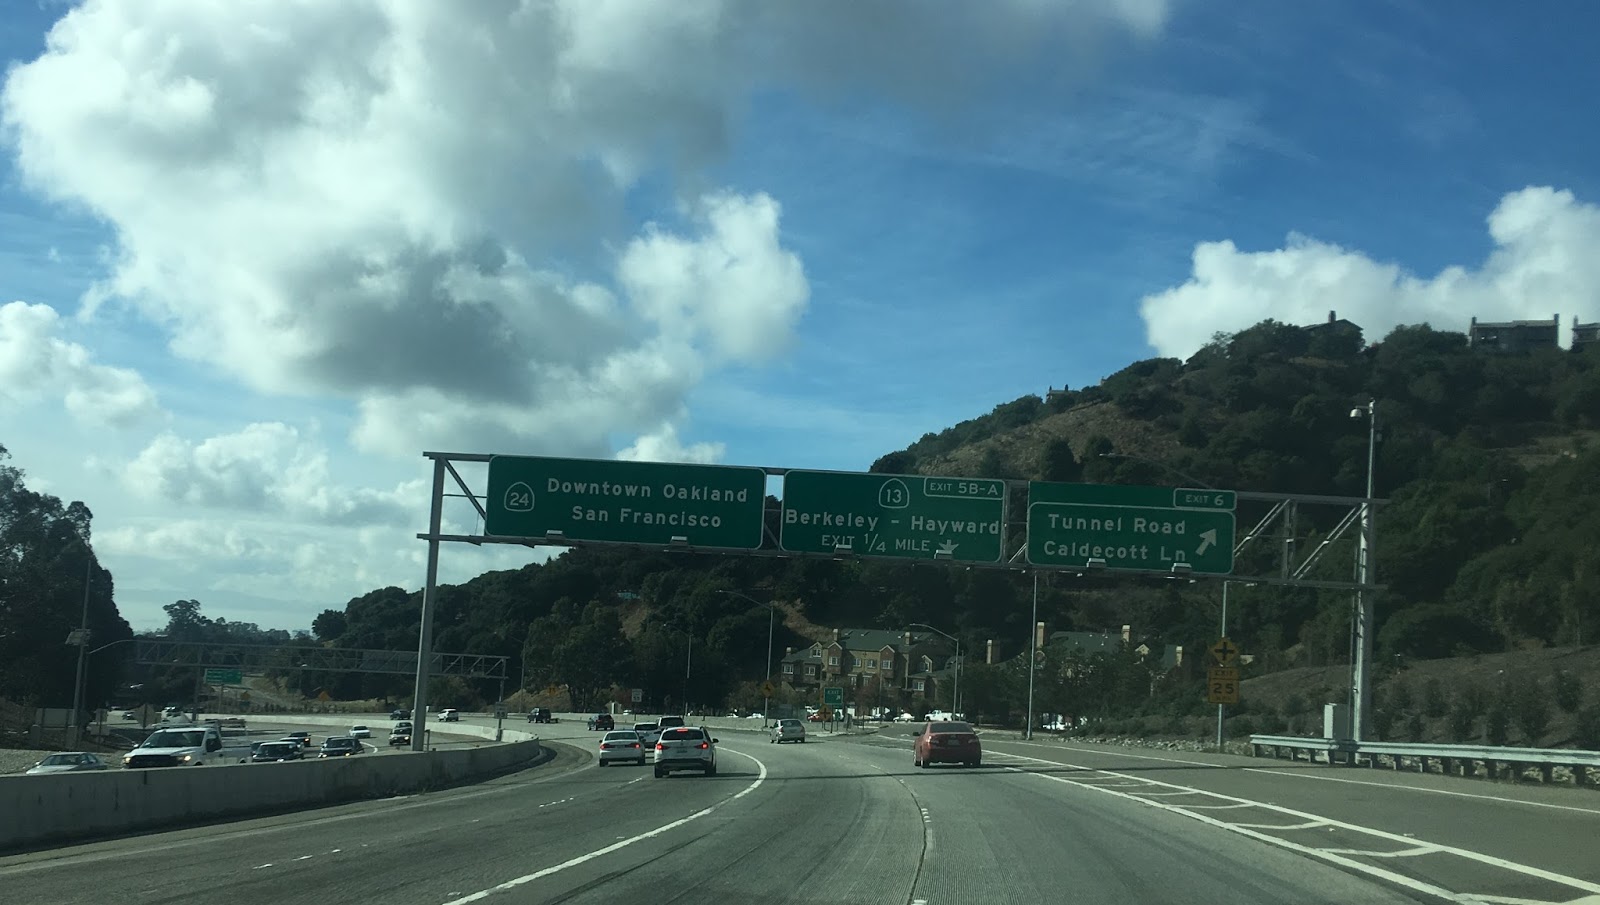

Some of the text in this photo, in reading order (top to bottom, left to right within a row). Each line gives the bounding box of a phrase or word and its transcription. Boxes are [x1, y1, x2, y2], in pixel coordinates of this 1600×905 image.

[547, 478, 747, 502] Downtown Oakland
[886, 488, 902, 504] 13
[929, 482, 998, 495] EXIT 5B-A
[509, 492, 530, 507] 24
[1185, 494, 1224, 506] EXIT 6
[572, 506, 721, 527] San Francisco
[785, 509, 879, 531] Berkeley
[911, 515, 999, 535] Hayward
[1048, 513, 1186, 535] Tunnel Road
[821, 534, 855, 547] EXIT
[895, 538, 930, 551] MILE
[1043, 540, 1186, 562] Caldecott Ln
[1213, 682, 1234, 695] 25
